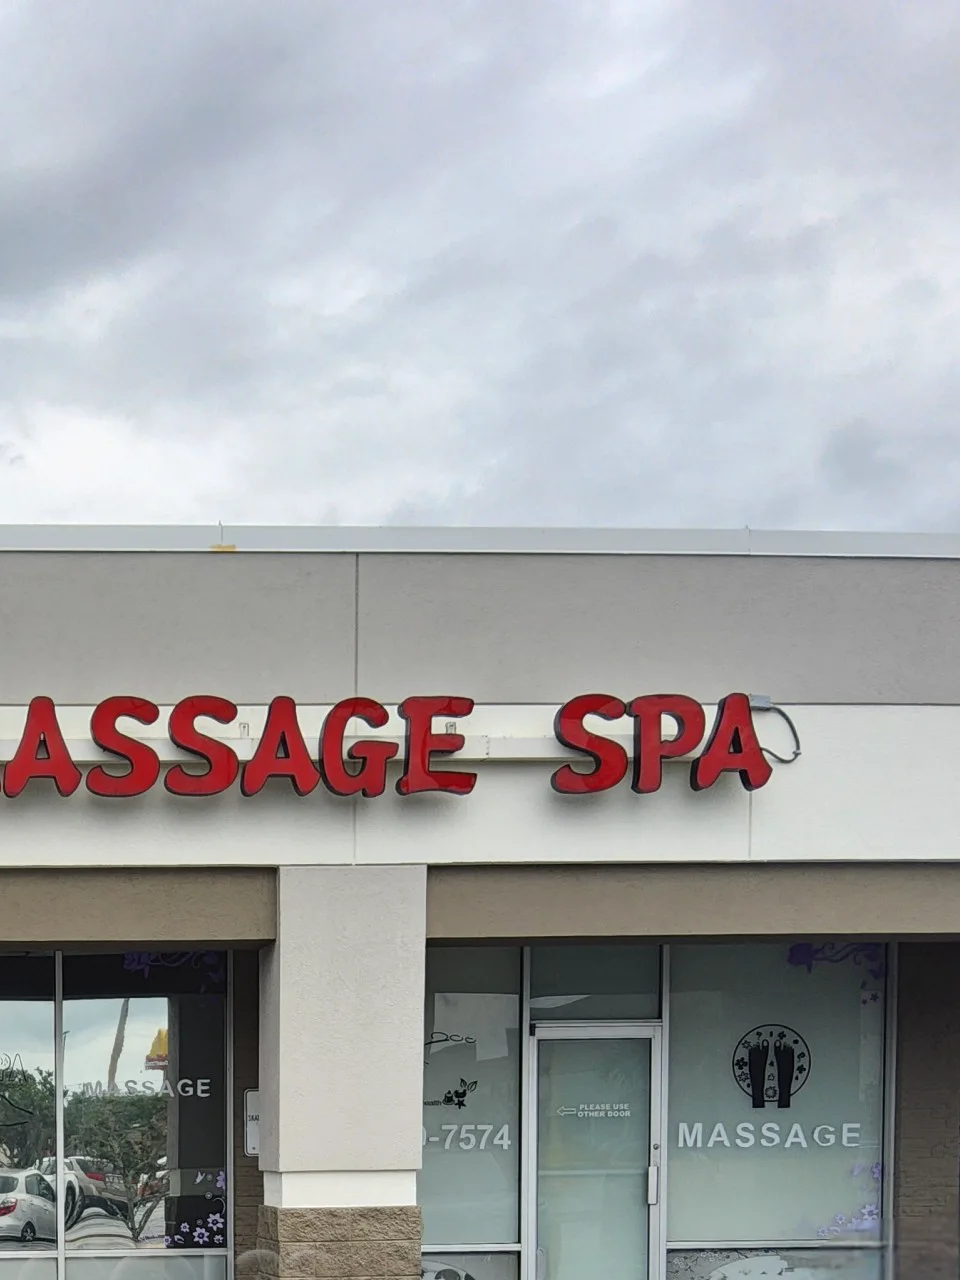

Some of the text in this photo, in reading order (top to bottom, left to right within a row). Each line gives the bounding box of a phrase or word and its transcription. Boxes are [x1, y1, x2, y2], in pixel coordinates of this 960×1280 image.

[550, 692, 772, 794] SPA
[82, 1079, 211, 1098] MASSAGE
[577, 1110, 631, 1118] OTHER DOOR
[422, 1124, 512, 1150] -7574
[677, 1122, 861, 1148] MASSAGE
